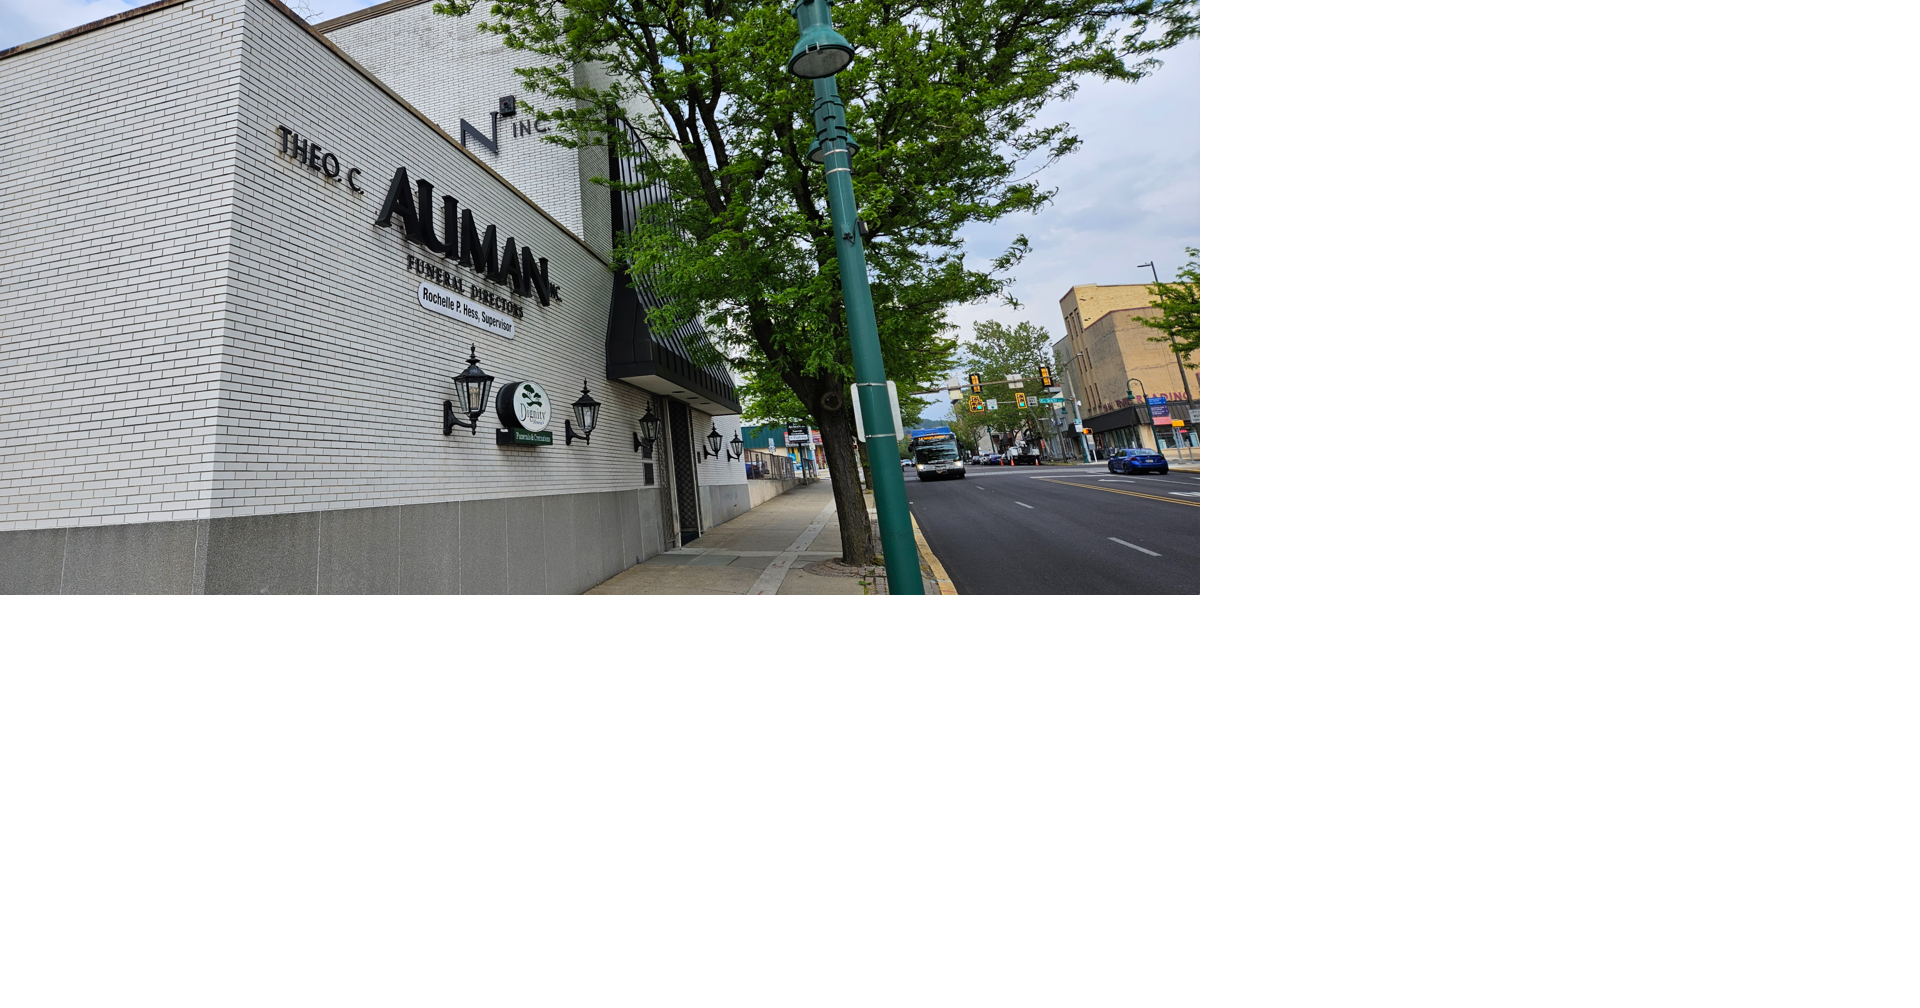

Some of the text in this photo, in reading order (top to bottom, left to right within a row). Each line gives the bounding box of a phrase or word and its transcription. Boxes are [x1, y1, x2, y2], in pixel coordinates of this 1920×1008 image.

[512, 119, 551, 138] INC.
[279, 125, 365, 195] THEO. C.
[374, 166, 551, 307] AUMAN
[406, 255, 524, 319] FUNERAL DIRECTORS
[422, 287, 512, 333] Rochelle P. Hess, Supervisor
[519, 403, 547, 422] Dignity
